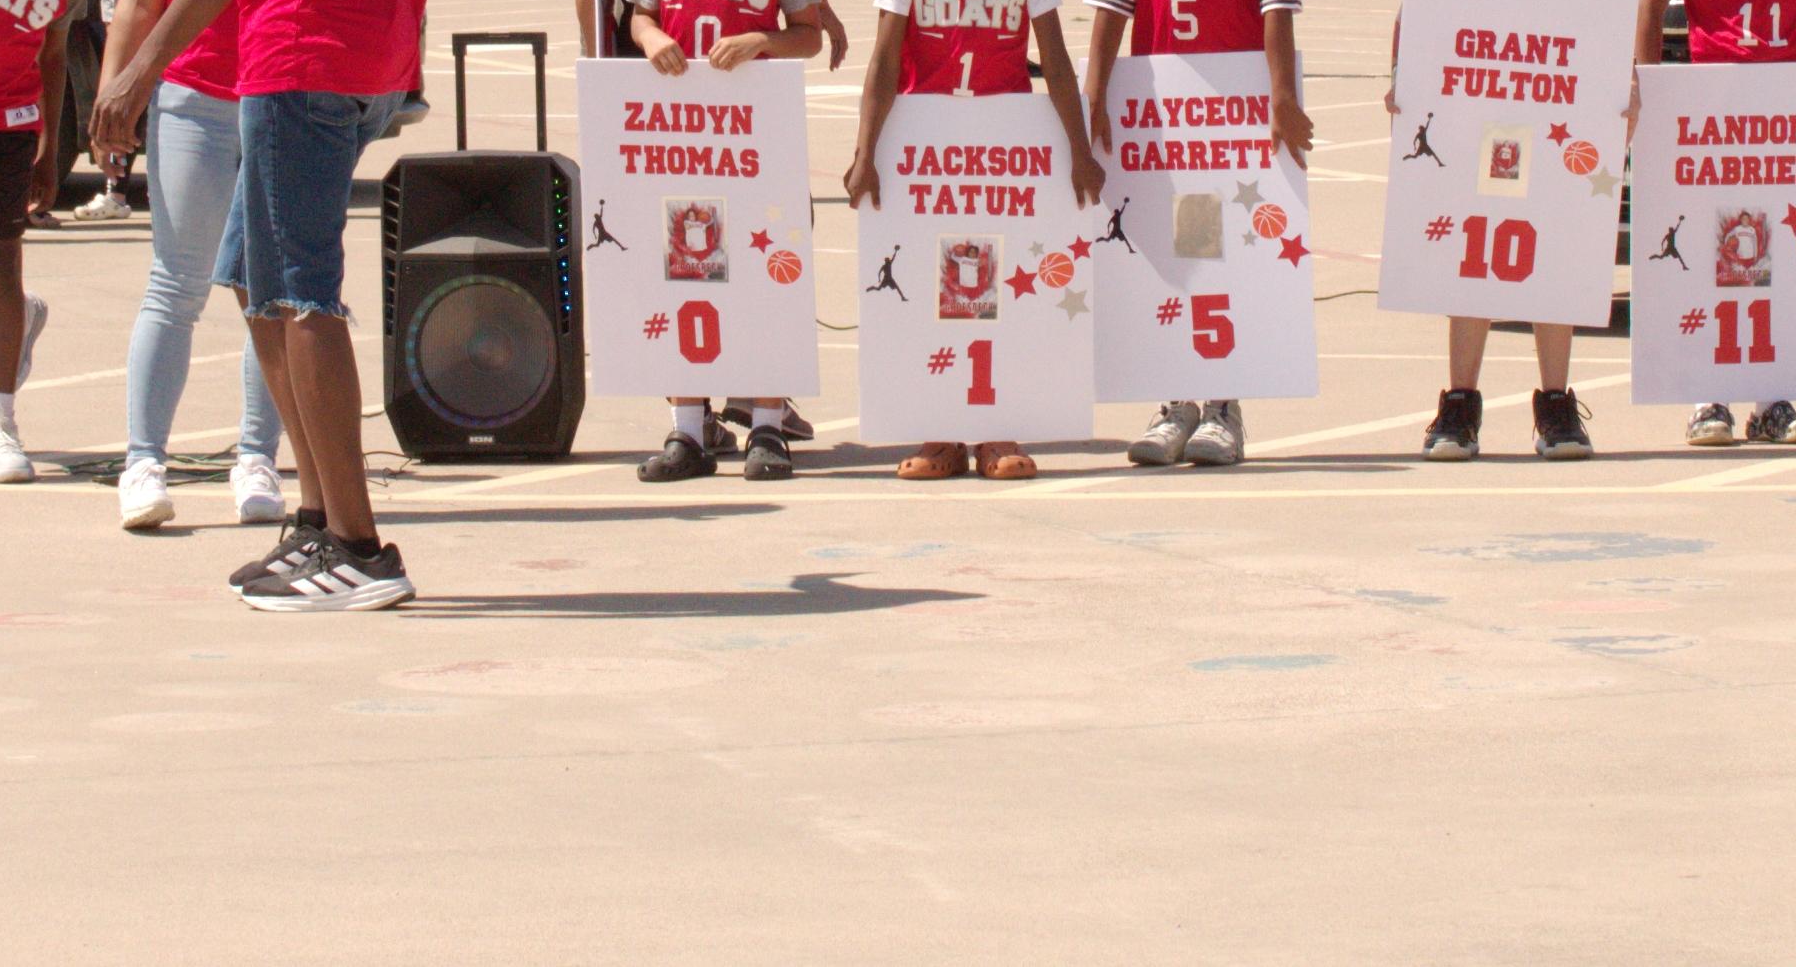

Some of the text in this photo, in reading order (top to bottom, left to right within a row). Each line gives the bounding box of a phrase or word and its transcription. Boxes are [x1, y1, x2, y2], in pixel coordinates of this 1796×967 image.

[694, 15, 722, 59] 0
[1737, 2, 1789, 47] 11
[1456, 29, 1575, 66] GRANT
[952, 51, 975, 97] 1
[1442, 66, 1578, 105] FULTON
[625, 102, 752, 136] ZAIDYN
[1120, 95, 1269, 128] JAYCEON
[620, 144, 759, 178] THOMAS
[897, 145, 1051, 176] JACKSON
[1121, 137, 1274, 172] GARRETT
[909, 184, 1035, 216] TATUM
